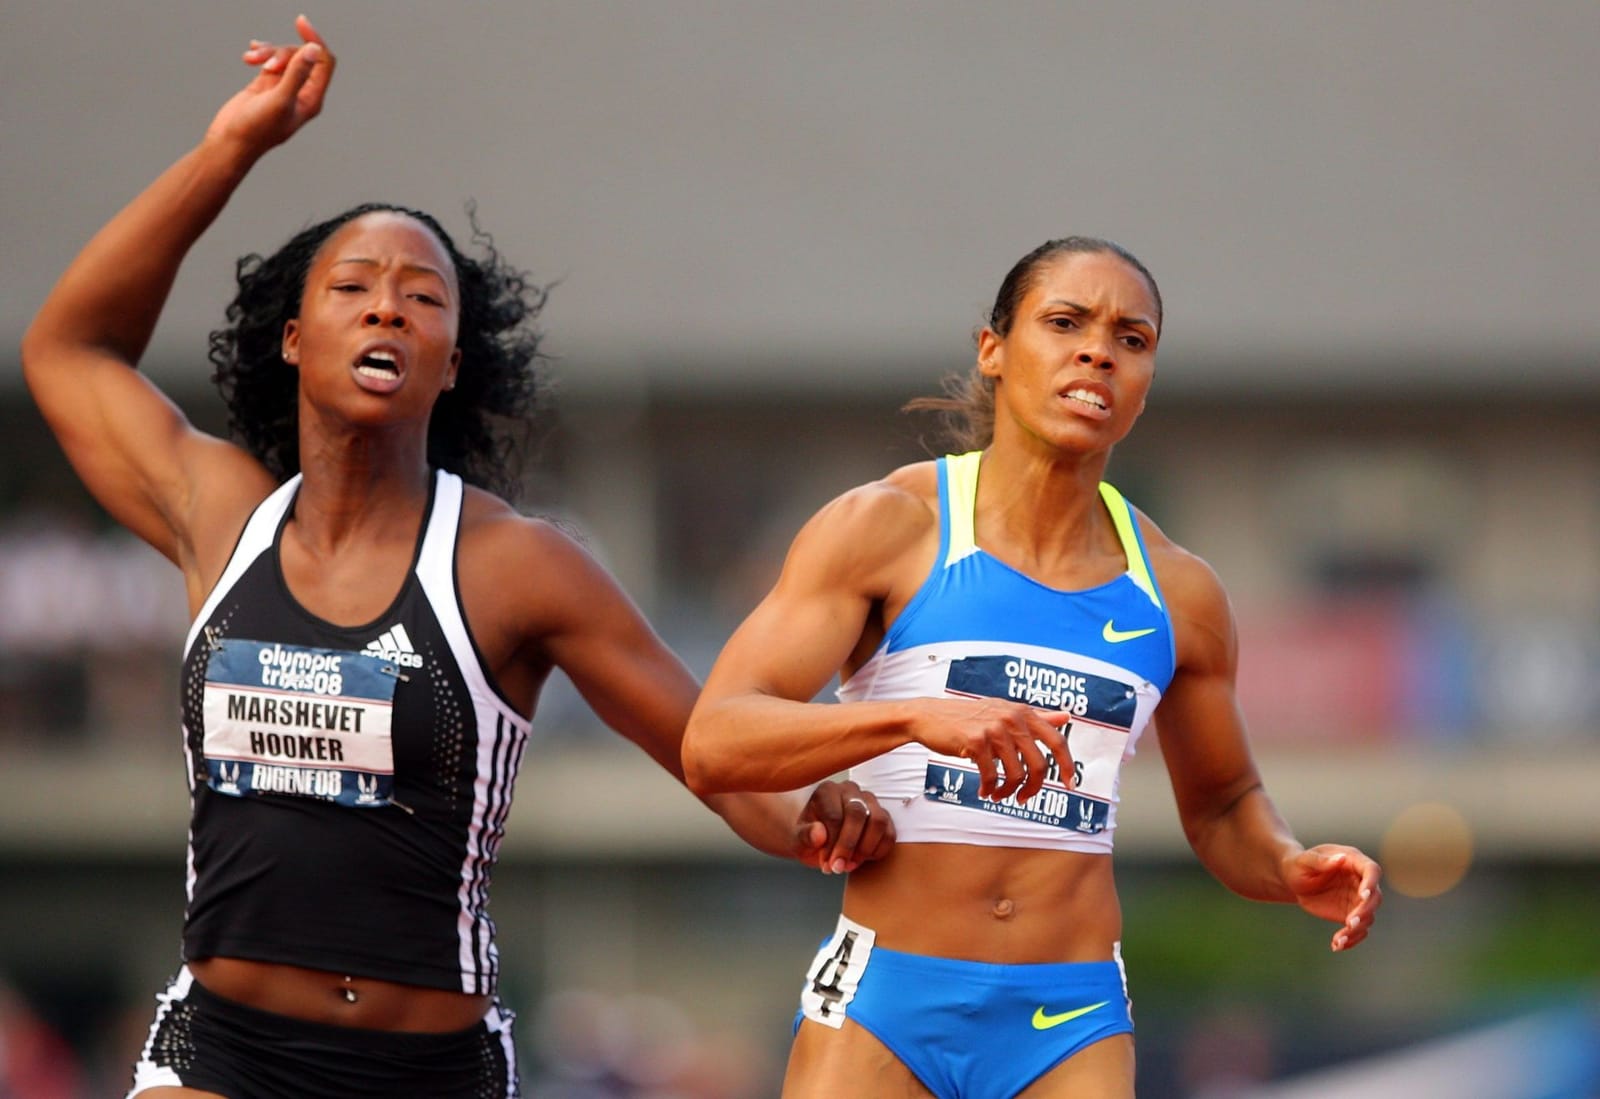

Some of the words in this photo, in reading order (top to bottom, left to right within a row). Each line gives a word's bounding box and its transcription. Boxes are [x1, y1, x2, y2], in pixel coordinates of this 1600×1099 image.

[258, 644, 342, 676] olympic
[1005, 658, 1087, 693] olympic
[227, 694, 365, 733] MARSHEVET
[250, 731, 344, 761] HOOKER
[251, 764, 342, 796] EUGENE08
[983, 803, 1030, 818] HAYWARD
[1032, 814, 1060, 825] FIELD
[812, 929, 859, 1018] 4
